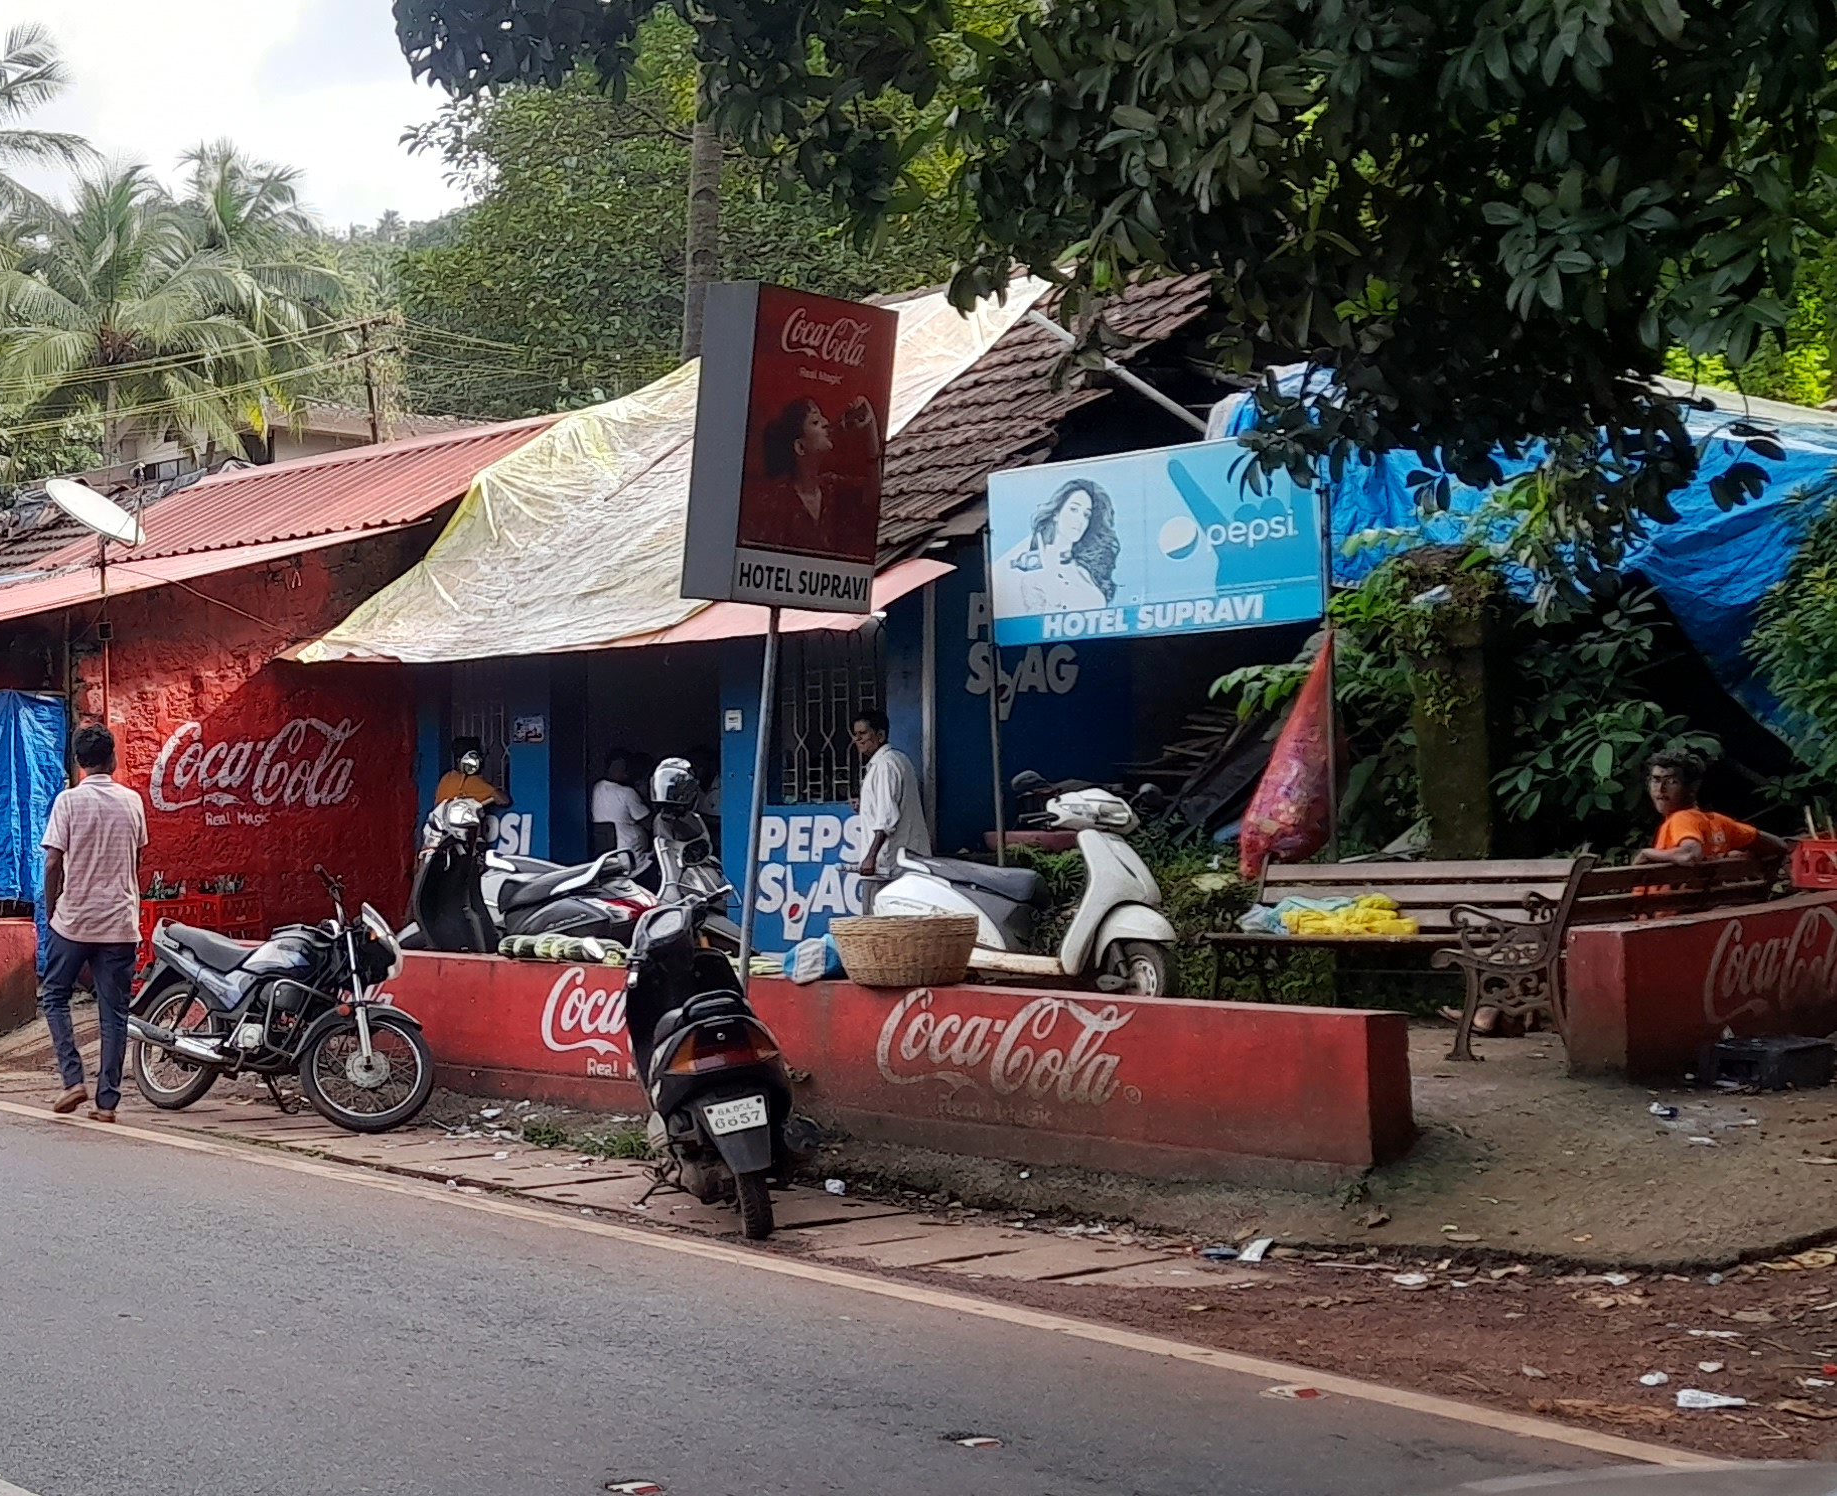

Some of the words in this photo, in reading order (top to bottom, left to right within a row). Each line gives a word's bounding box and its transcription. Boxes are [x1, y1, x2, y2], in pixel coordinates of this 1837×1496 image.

[1207, 508, 1296, 550] pepsi
[738, 562, 794, 593] HOTEL
[798, 570, 869, 602] SUPRAVI
[1041, 611, 1129, 639] HOTEL
[1136, 594, 1264, 631] SUPRAVI
[149, 718, 365, 812] Coca-Cola
[204, 811, 231, 826] Real
[236, 811, 270, 827] Magic
[875, 987, 1138, 1106] Coca-Cola
